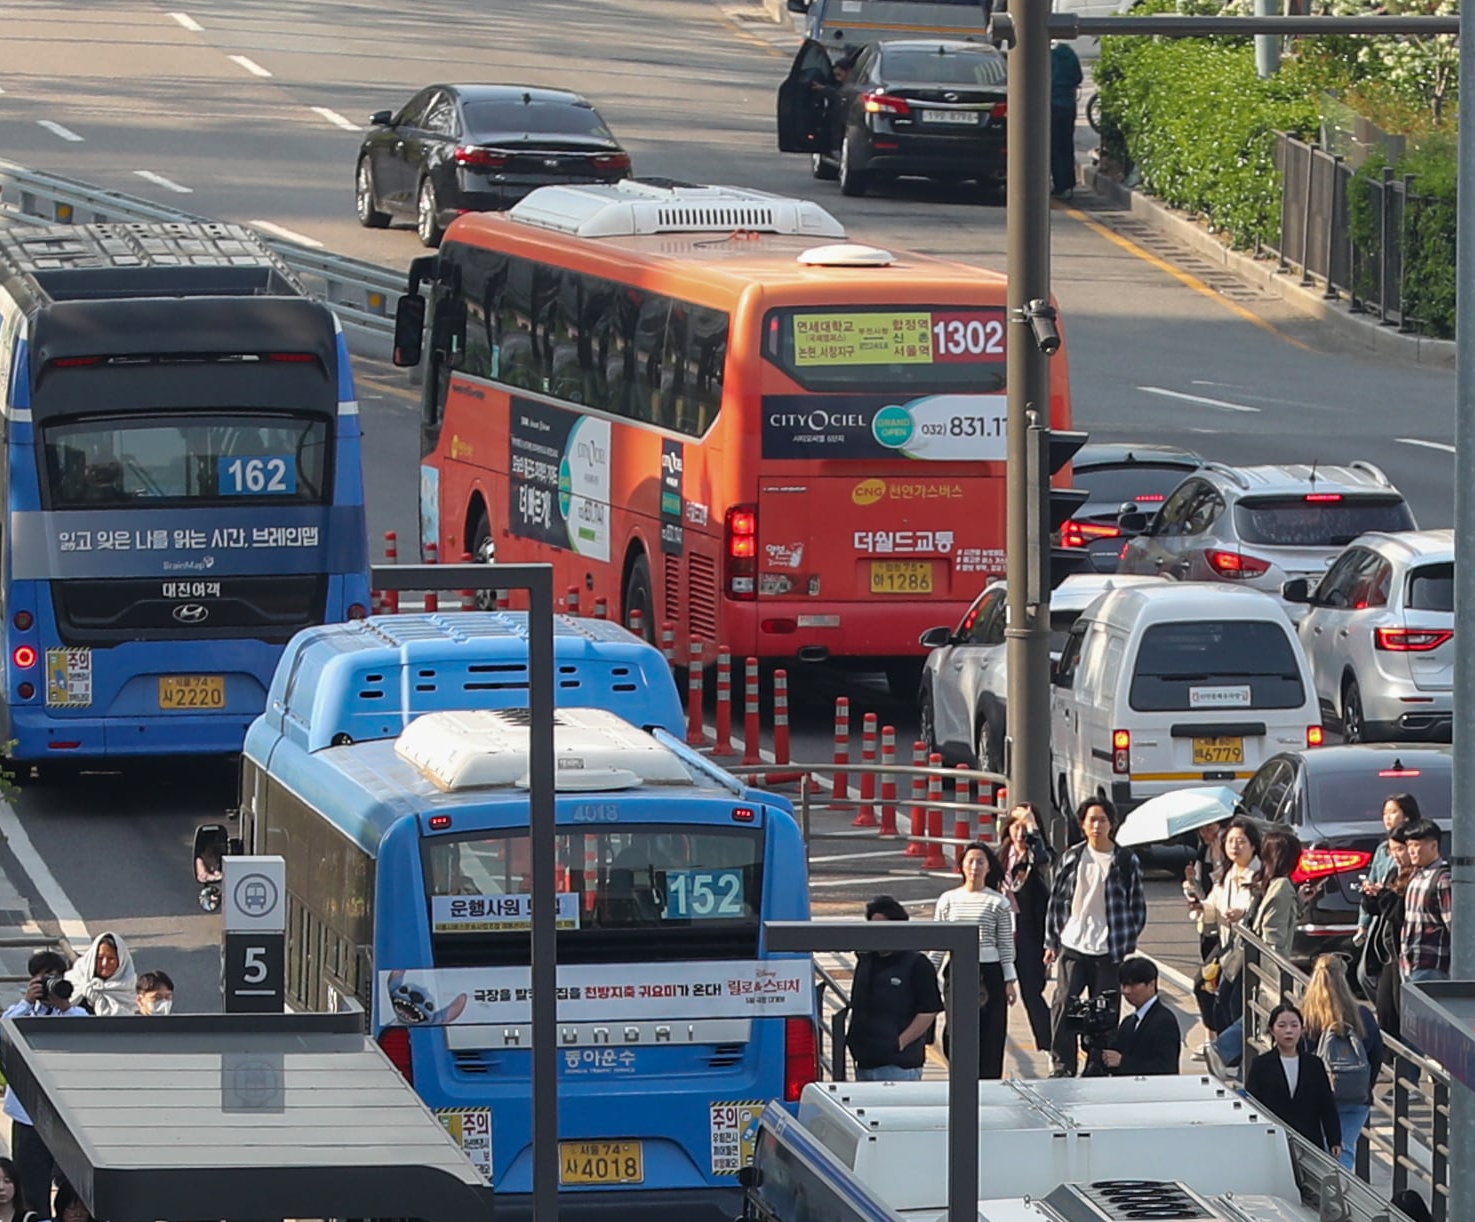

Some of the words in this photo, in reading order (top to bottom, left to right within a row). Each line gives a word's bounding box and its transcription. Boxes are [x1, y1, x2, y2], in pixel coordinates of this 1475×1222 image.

[797, 319, 854, 333] 연세대학교
[892, 319, 929, 331] 합정역
[933, 320, 1004, 354] 1302
[892, 345, 930, 356] 서울역
[227, 459, 287, 492] 162
[854, 486, 884, 498] CNG
[135, 529, 168, 550] 나를
[211, 528, 248, 548] 시간,
[252, 526, 319, 548] 브레인맵
[853, 531, 954, 553] 더월드교통
[162, 559, 206, 572] BrainMap
[162, 582, 221, 598] 대진여객
[68, 652, 89, 671] 주의
[670, 873, 741, 915] 152
[450, 898, 520, 918] 운행사원
[243, 947, 268, 984] 5
[474, 989, 511, 1002] 극장을
[584, 985, 636, 1000] 천방지축
[638, 983, 689, 999] 귀요미가
[693, 982, 721, 998] 온다!
[503, 1026, 694, 1045] HUNDAI
[564, 1049, 637, 1066] 동아운수
[462, 1114, 489, 1135] 주의
[712, 1107, 738, 1130] 주의
[602, 1143, 620, 1155] 74
